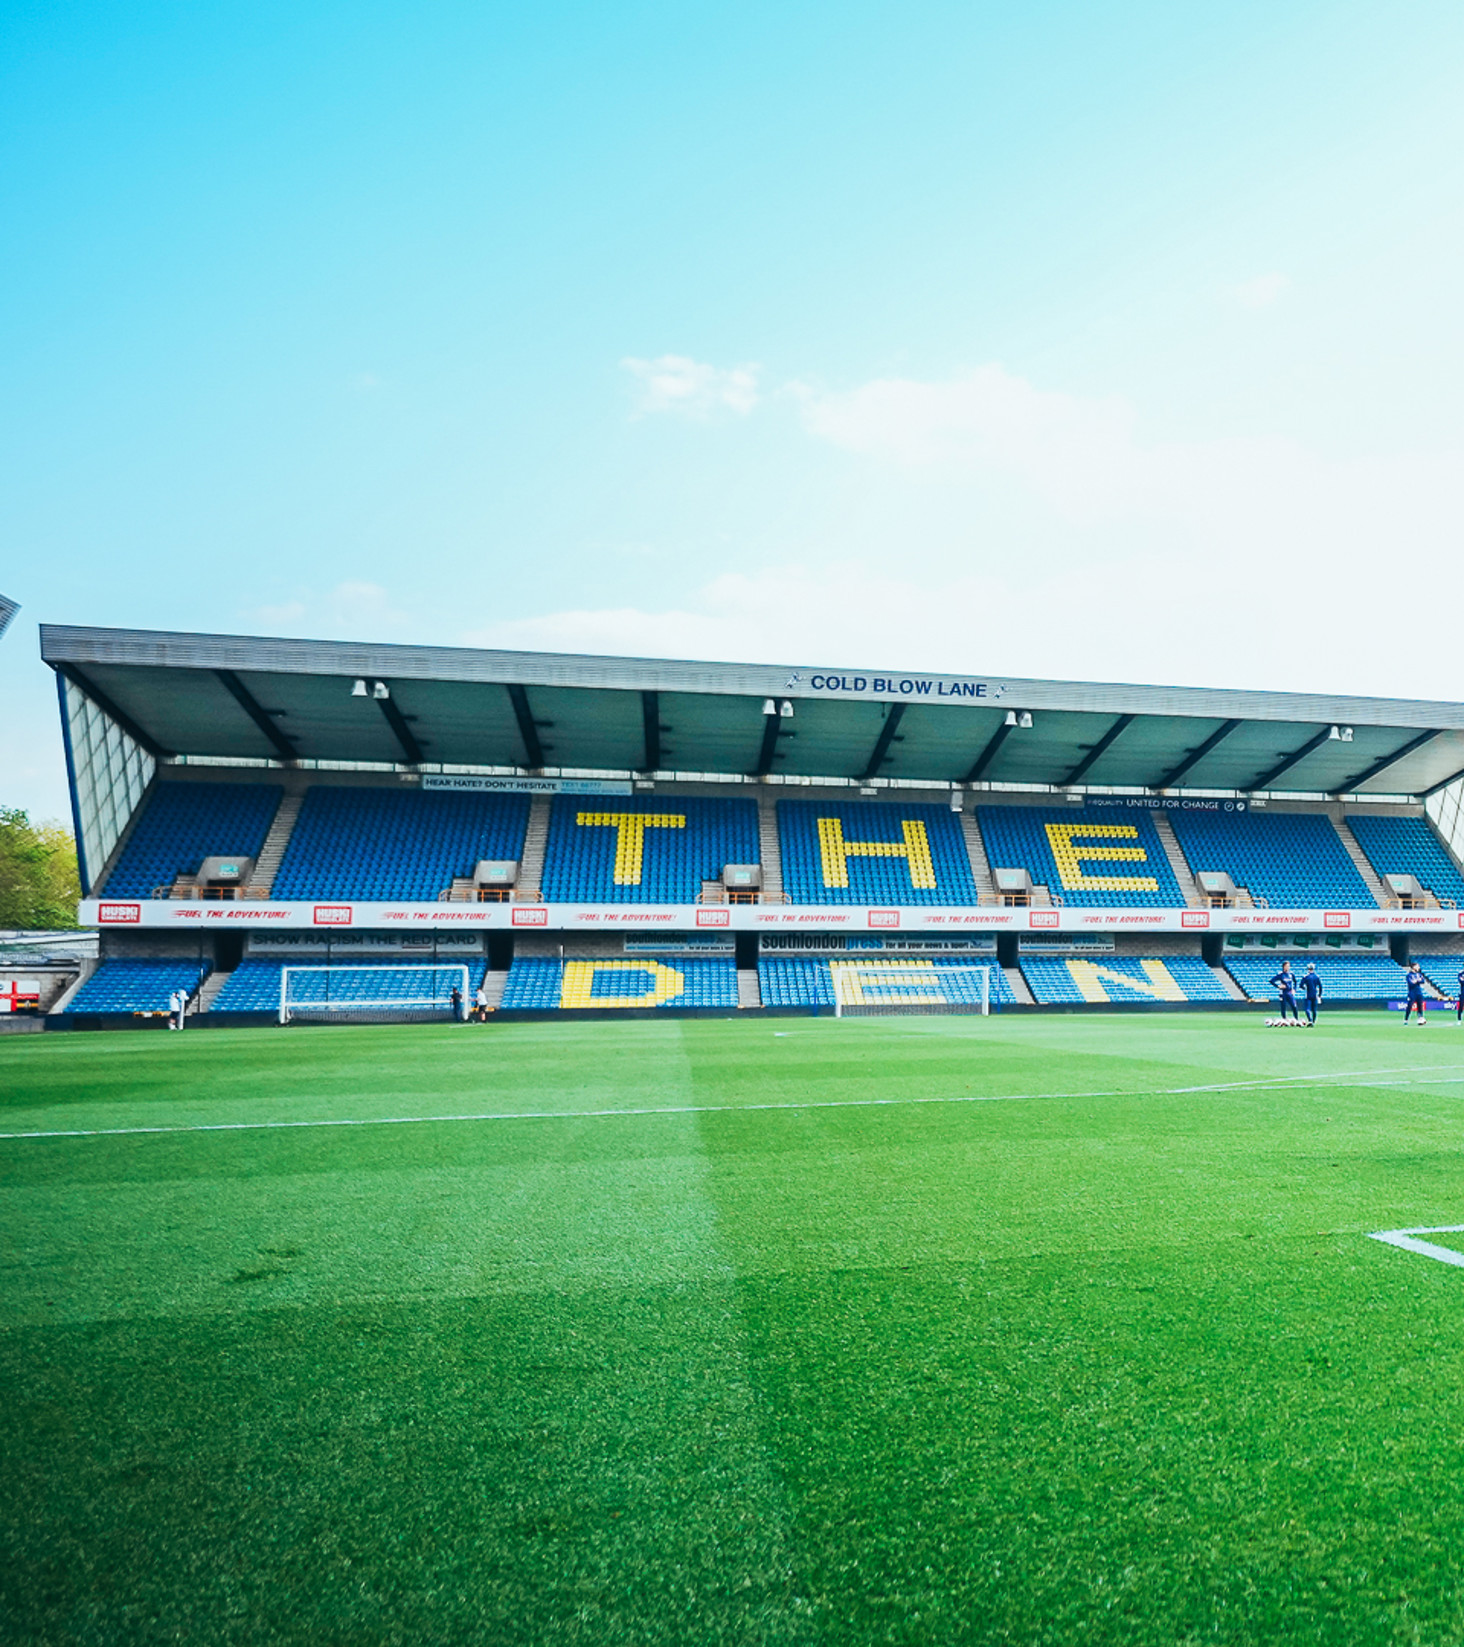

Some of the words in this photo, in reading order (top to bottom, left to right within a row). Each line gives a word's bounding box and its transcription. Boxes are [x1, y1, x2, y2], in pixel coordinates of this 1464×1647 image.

[811, 675, 867, 691] COLD
[873, 678, 933, 695] BLOW
[938, 682, 988, 698] LANE
[426, 778, 450, 786] HEAR
[454, 779, 483, 788] HATE?
[485, 780, 513, 789] DON'T
[517, 781, 557, 791] HESITATE
[1126, 798, 1160, 808] UNITED
[1162, 799, 1180, 808] FOR
[1182, 800, 1220, 809] CHANGE
[101, 906, 137, 915] HUSKI
[206, 910, 224, 918] THE
[227, 910, 292, 920] ADVENTURE!
[317, 909, 349, 917] HUSKI
[412, 912, 428, 920] THE
[432, 912, 492, 921] ADVENTURE!
[603, 913, 619, 921] THE
[781, 914, 796, 922] THE
[253, 934, 299, 945] SHOW
[305, 934, 363, 945] RACISM
[368, 934, 397, 945] THE
[401, 935, 431, 945] RED
[434, 935, 476, 945] CARD
[1444, 1001, 1457, 1010] sky
